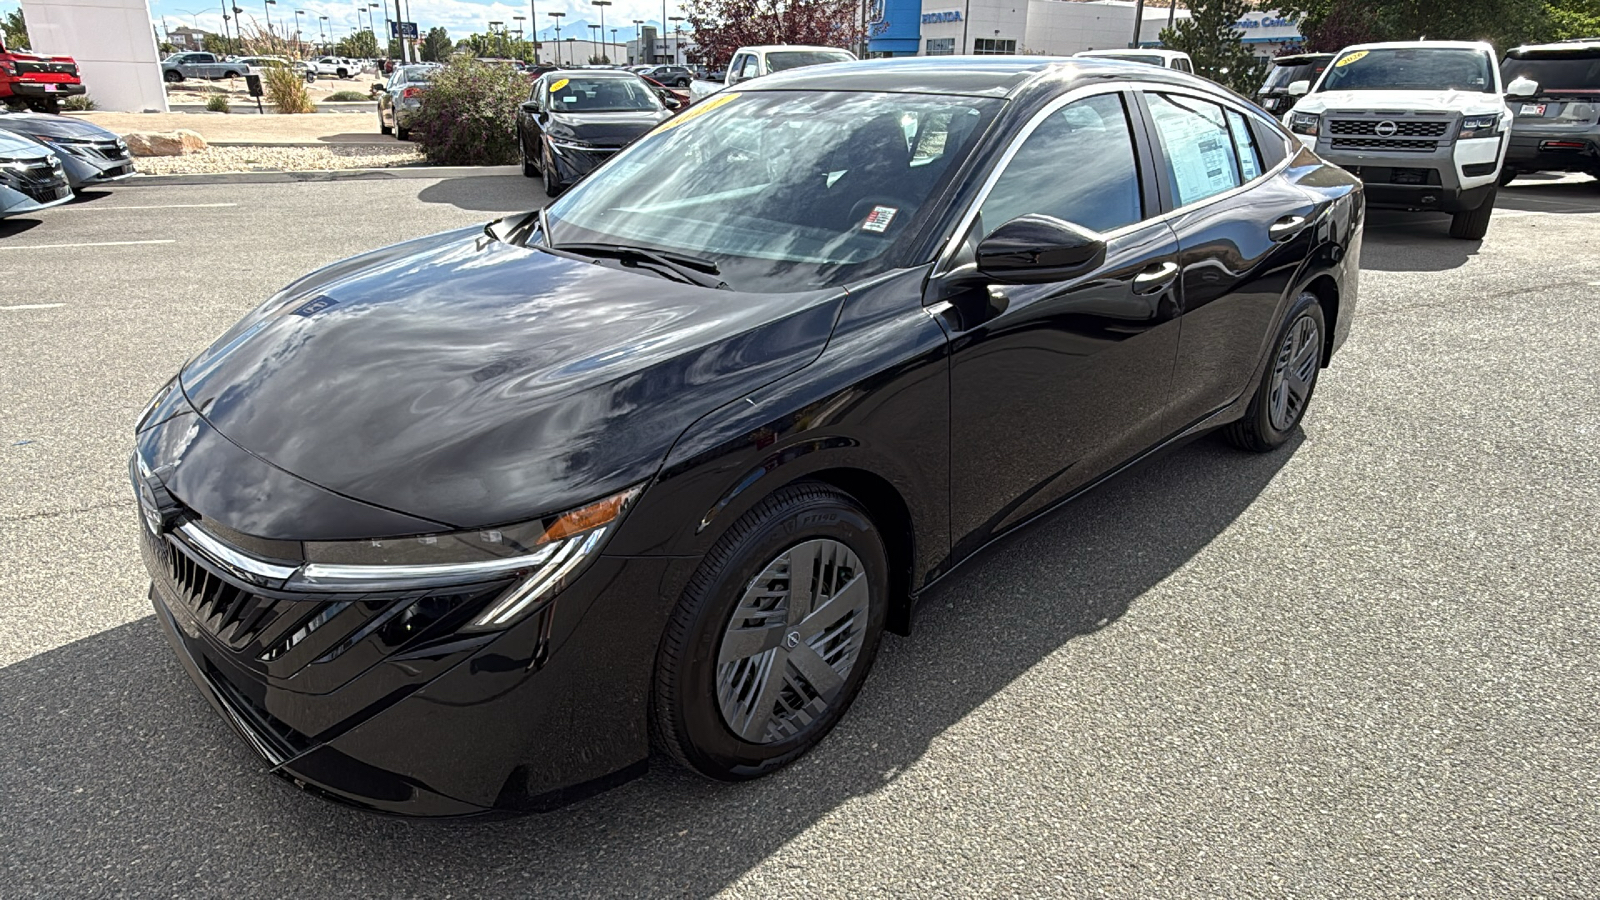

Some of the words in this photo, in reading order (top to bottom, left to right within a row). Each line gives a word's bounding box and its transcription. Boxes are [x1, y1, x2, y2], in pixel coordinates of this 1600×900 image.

[922, 10, 963, 24] HONDA
[1342, 52, 1363, 64] 2026
[804, 513, 838, 525] FT140
